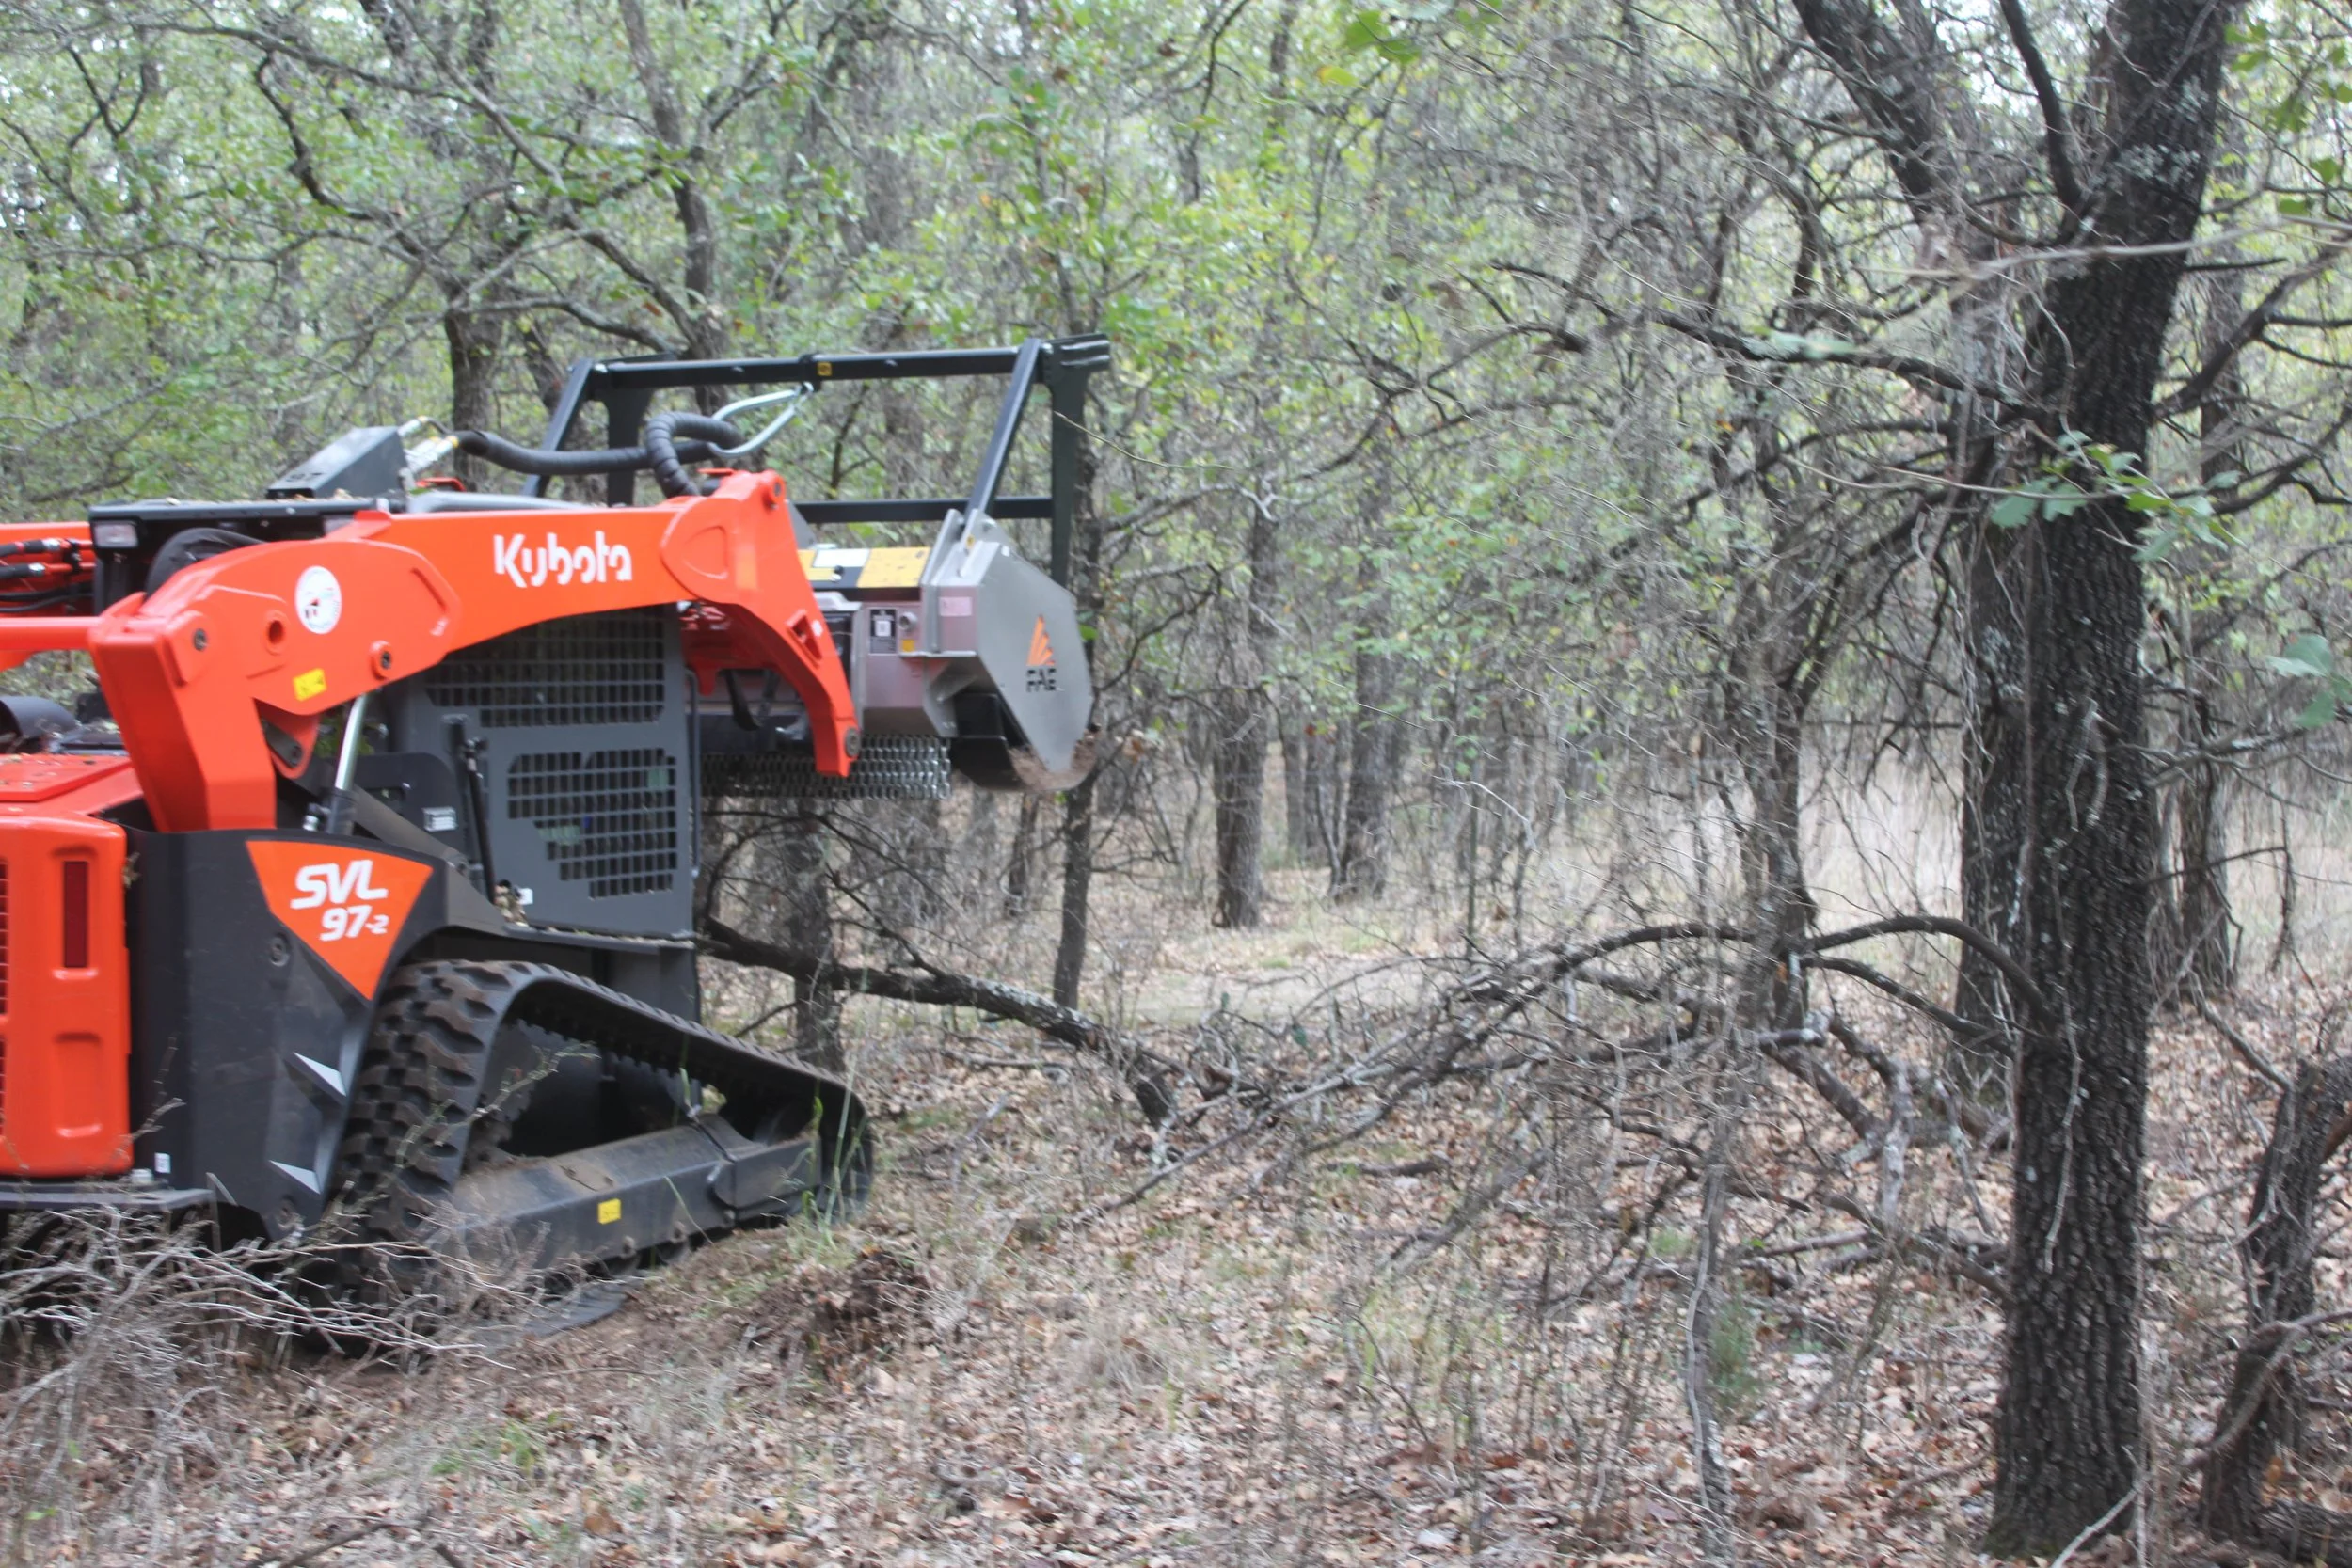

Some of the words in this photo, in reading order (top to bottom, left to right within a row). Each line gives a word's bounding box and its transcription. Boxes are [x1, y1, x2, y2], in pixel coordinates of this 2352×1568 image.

[493, 530, 633, 588] Kubota
[290, 859, 389, 910] SVL
[320, 904, 389, 942] 97-2
